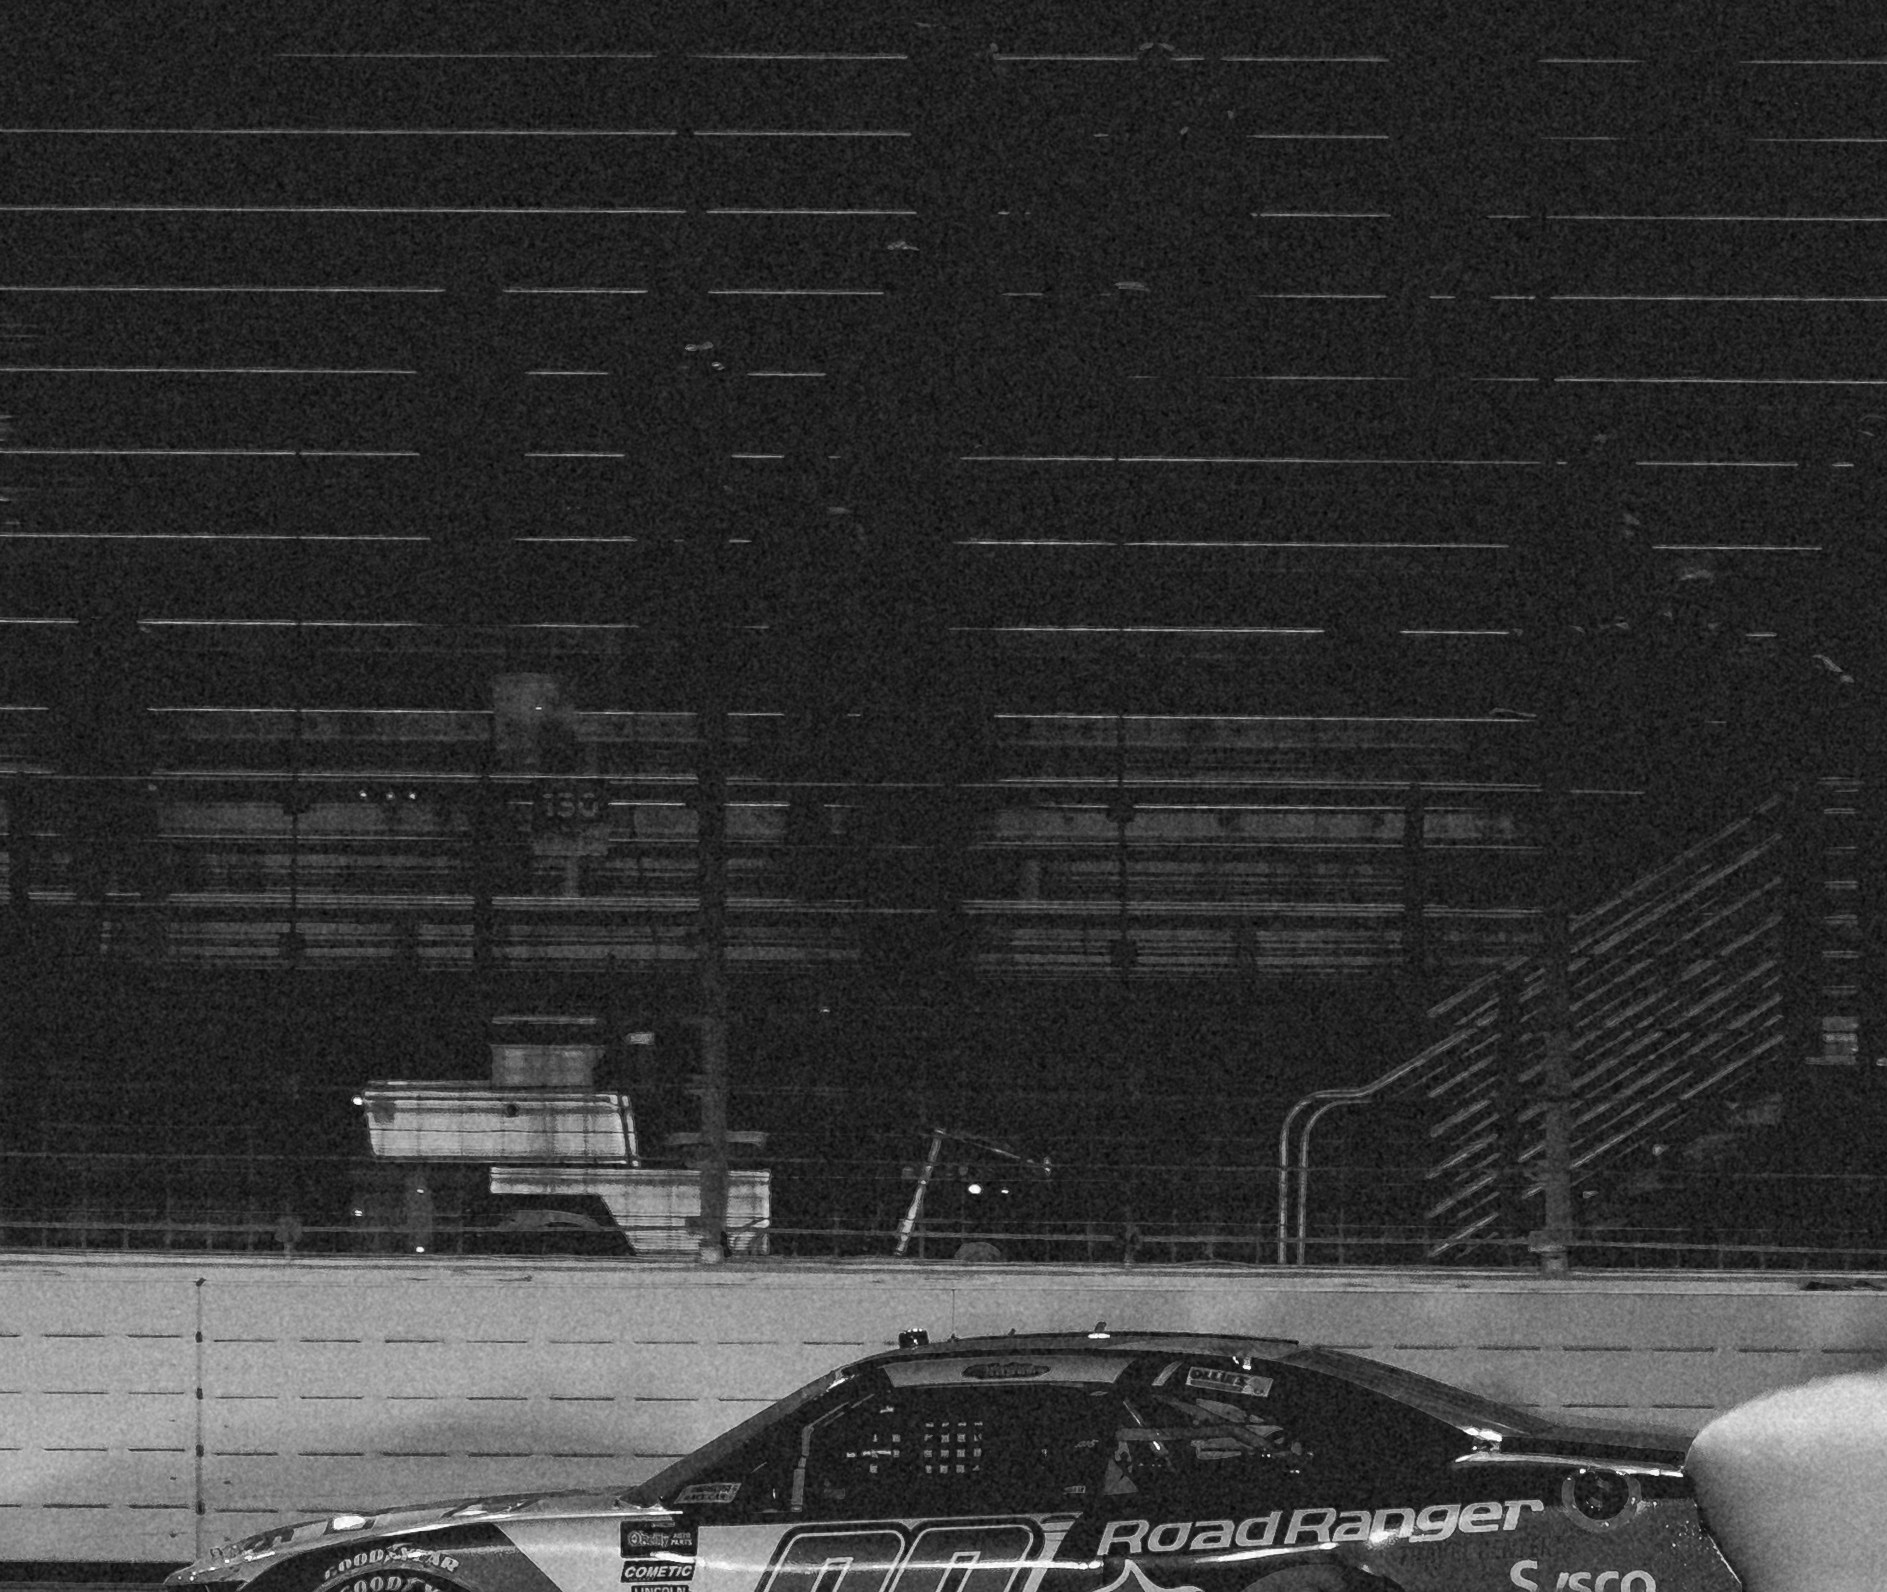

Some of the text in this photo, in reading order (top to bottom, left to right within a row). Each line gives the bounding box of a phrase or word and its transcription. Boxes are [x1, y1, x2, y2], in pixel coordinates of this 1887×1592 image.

[1096, 1499, 1545, 1556] Road Ranger
[624, 1565, 692, 1578] COMETIC
